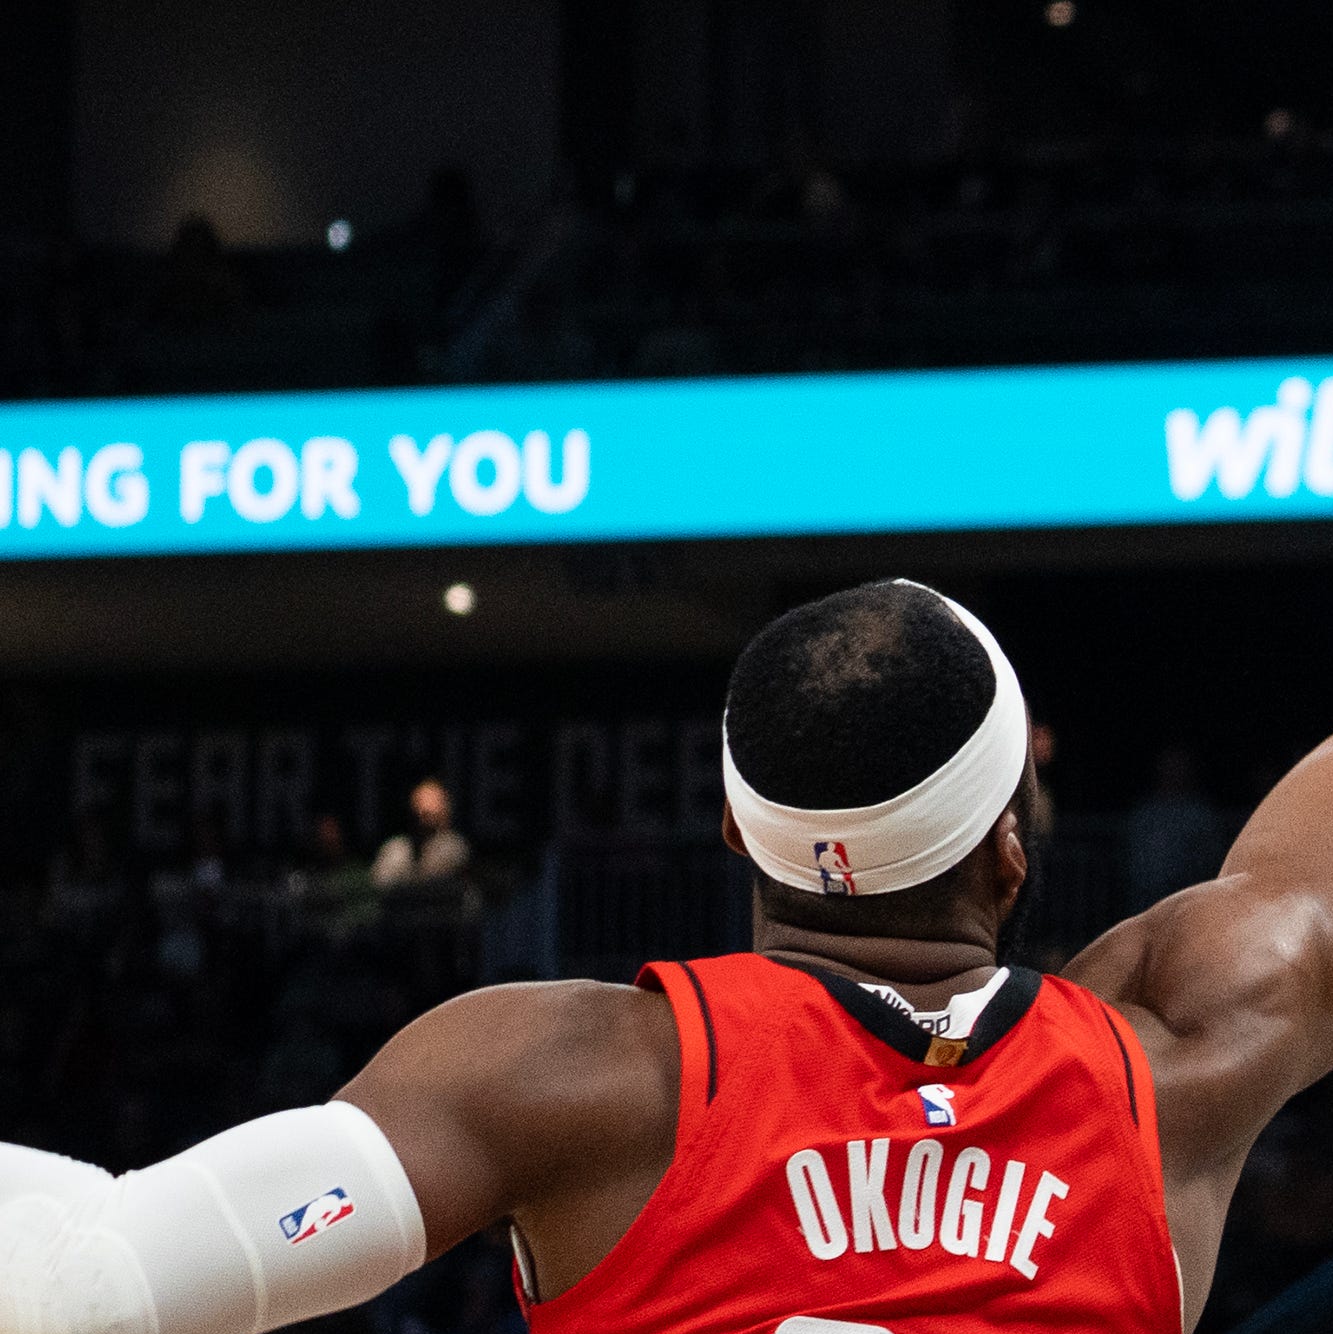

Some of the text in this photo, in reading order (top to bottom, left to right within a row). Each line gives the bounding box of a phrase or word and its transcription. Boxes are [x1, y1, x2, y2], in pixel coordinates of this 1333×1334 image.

[179, 436, 361, 524] FOR
[389, 428, 590, 517] YOU
[71, 728, 316, 848] FEAR
[786, 1137, 1070, 1280] OKOGIE
